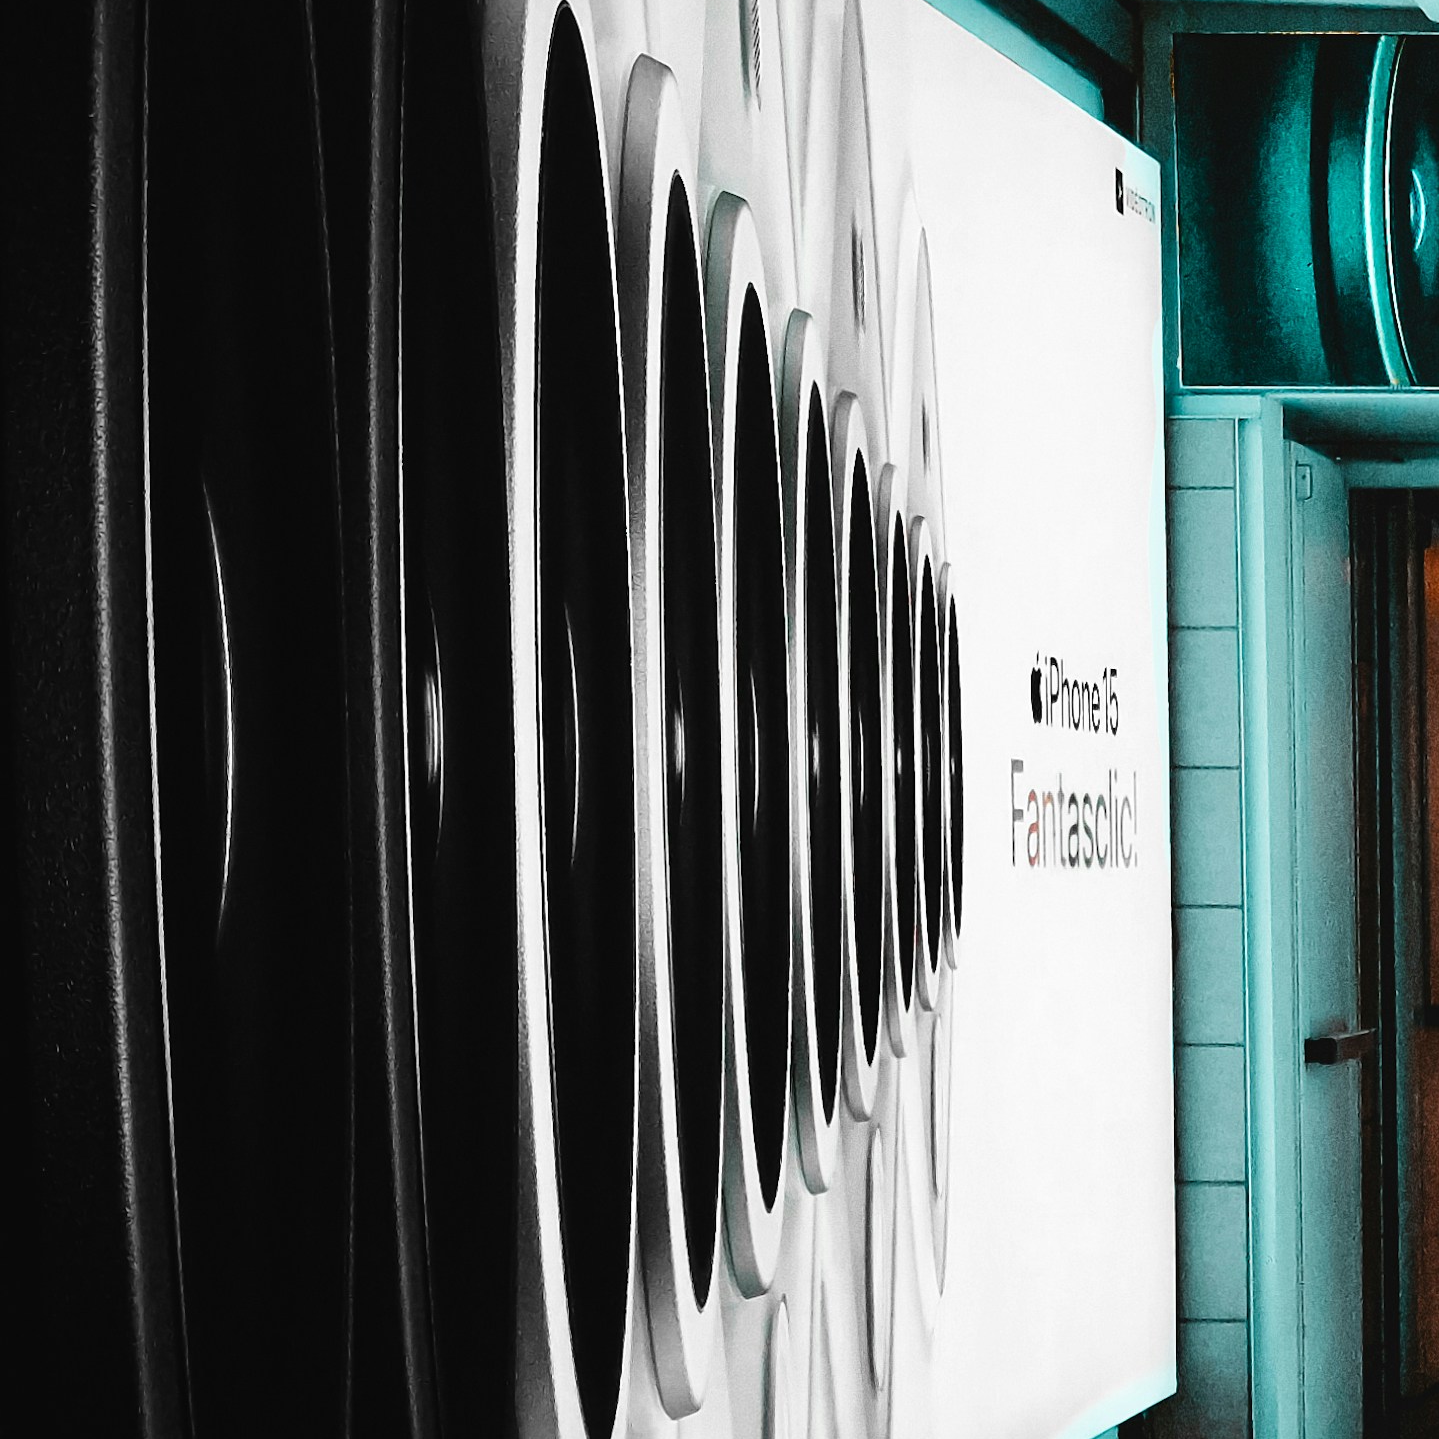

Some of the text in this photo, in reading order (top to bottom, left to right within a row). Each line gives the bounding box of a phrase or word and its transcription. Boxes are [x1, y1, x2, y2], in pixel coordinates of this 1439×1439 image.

[1044, 655, 1119, 736] iPhone 15
[1010, 758, 1138, 869] Fantasclic!
